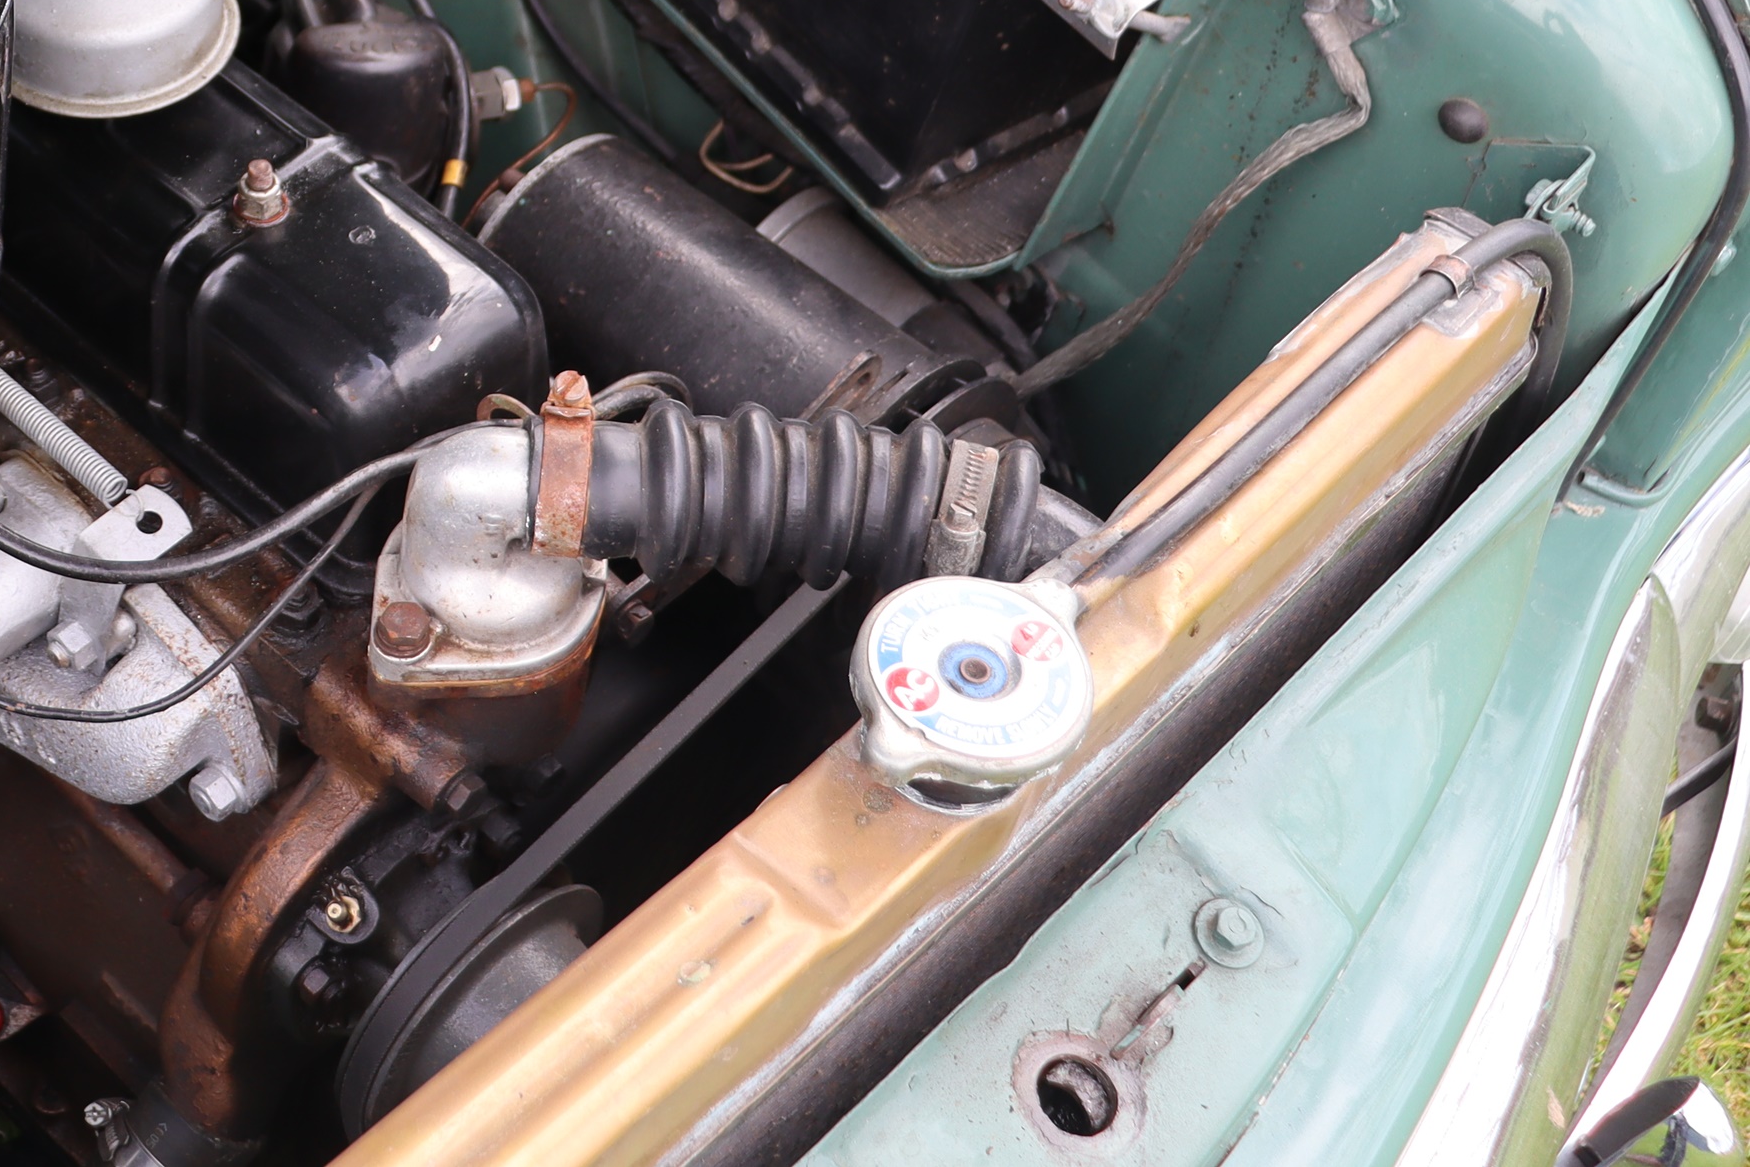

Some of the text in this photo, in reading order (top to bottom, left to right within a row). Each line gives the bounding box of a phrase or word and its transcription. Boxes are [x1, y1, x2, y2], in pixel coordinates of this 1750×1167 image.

[879, 610, 913, 652] TURN
[893, 669, 935, 711] AC
[934, 711, 1007, 745] REMOVE
